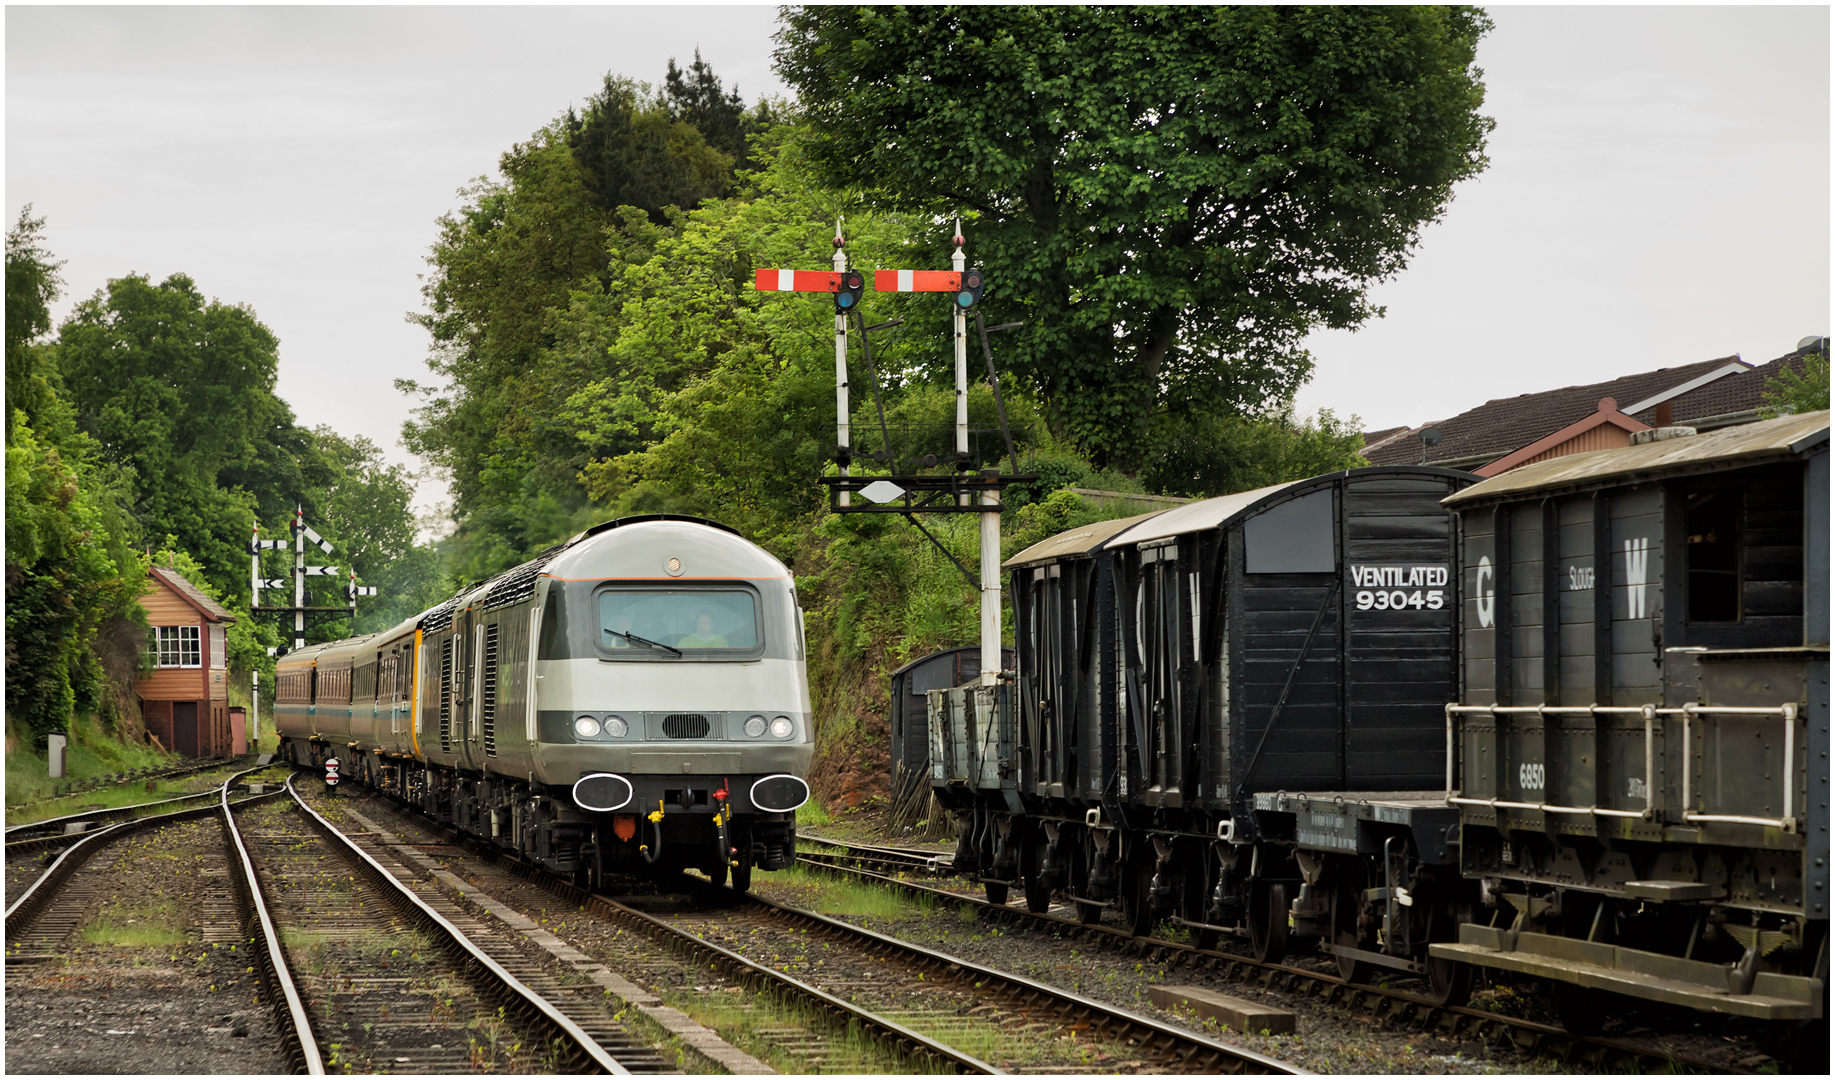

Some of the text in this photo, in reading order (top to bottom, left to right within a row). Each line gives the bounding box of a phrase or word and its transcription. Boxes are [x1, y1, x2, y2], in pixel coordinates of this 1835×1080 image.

[1350, 565, 1448, 587] VENTILATED
[1477, 538, 1648, 628] G W
[1356, 590, 1444, 611] 93045
[1519, 763, 1545, 790] 6850
